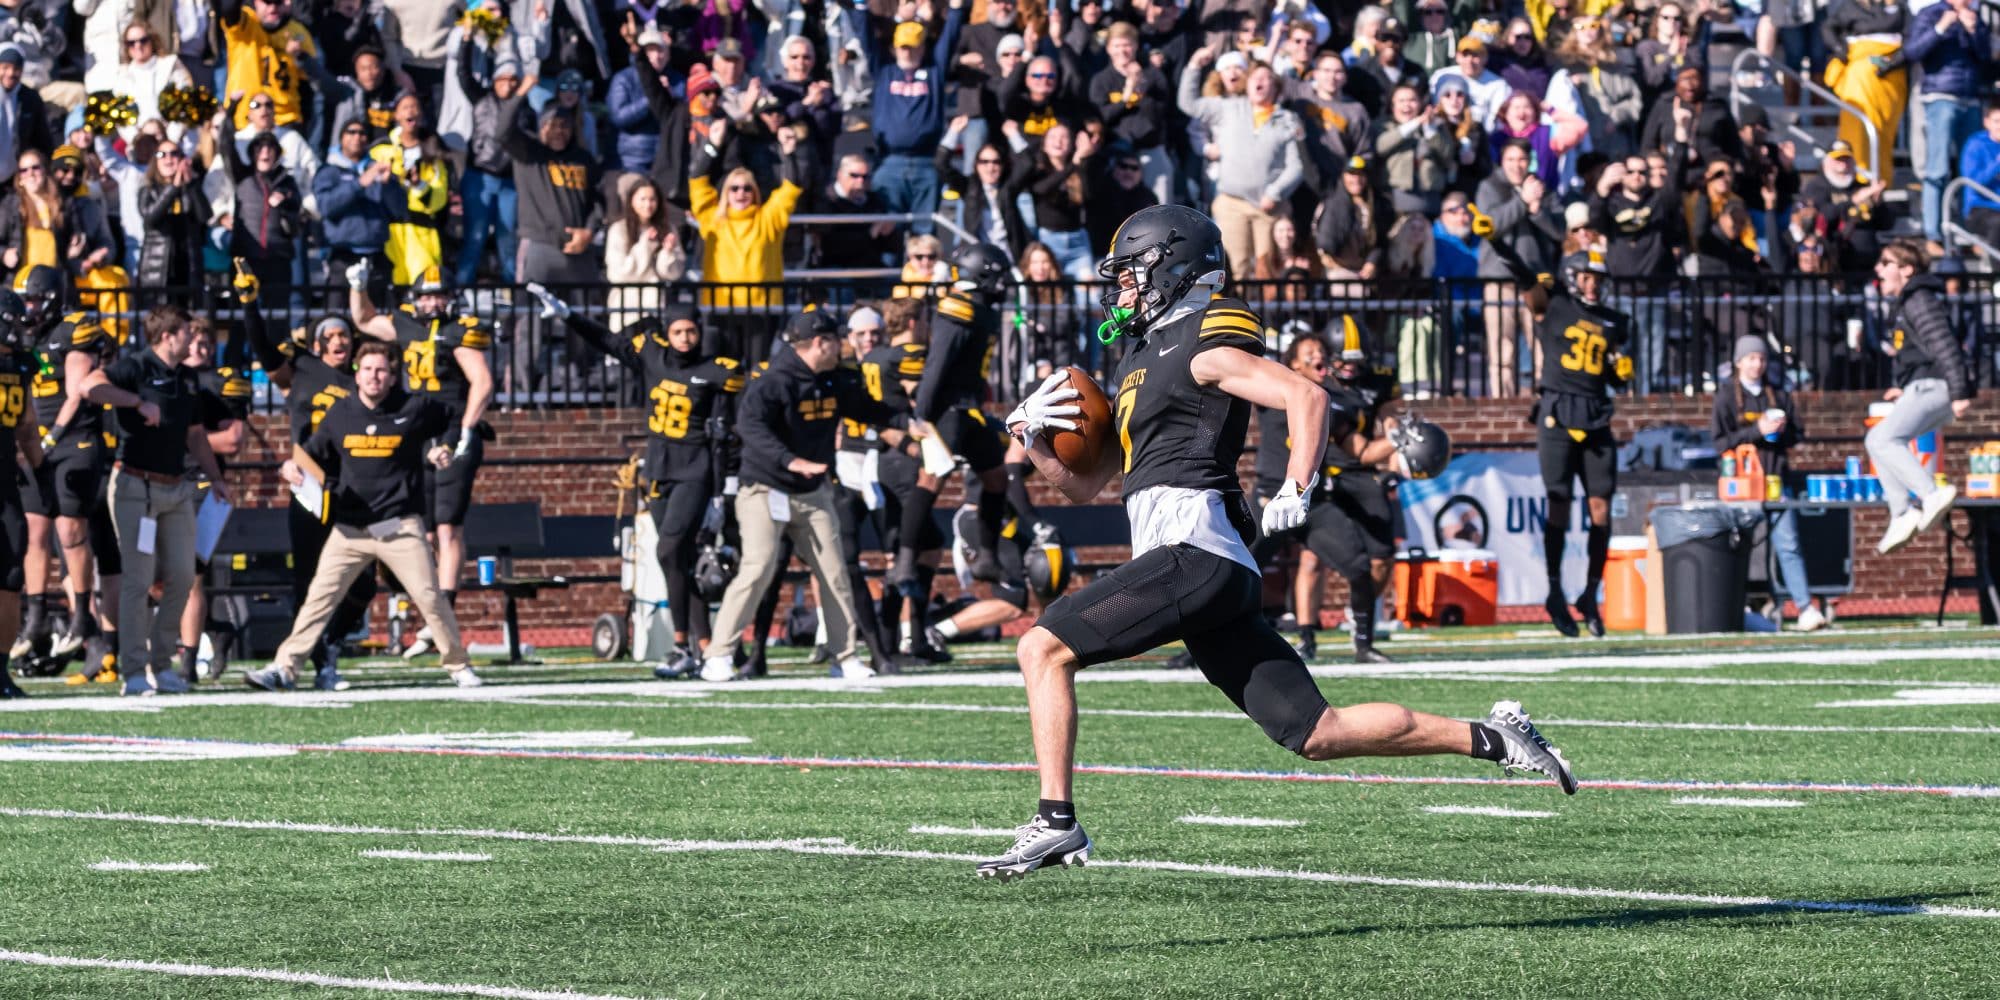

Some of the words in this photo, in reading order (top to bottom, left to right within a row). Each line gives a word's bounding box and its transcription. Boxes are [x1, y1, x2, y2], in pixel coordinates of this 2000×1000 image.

[260, 56, 291, 91] 14
[1560, 325, 1608, 375] 30
[648, 387, 692, 439] 38
[1117, 388, 1137, 474] 7
